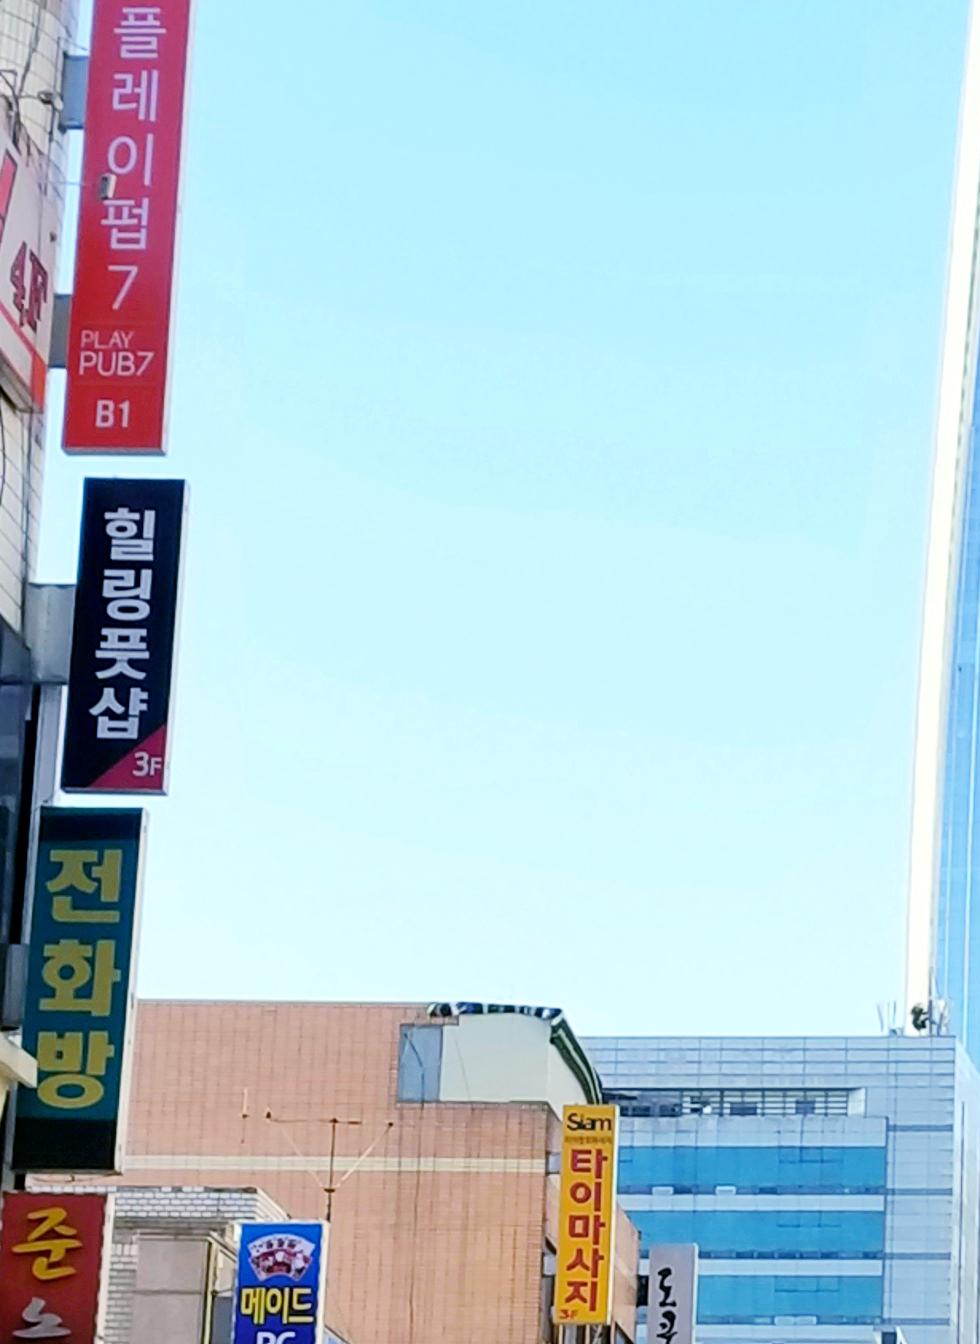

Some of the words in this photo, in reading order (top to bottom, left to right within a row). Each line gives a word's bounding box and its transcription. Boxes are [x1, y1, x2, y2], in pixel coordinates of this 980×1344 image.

[81, 330, 134, 350] PLAY
[78, 352, 154, 377] PUB7
[95, 399, 131, 428] B1
[88, 507, 156, 740] 힐링풋샵
[132, 751, 164, 777] 3F
[36, 848, 121, 1111] 전화방
[566, 1113, 611, 1132] Siam
[12, 1207, 83, 1281] 준
[564, 1148, 608, 1312] 타이마사지
[239, 1288, 315, 1325] 메이드
